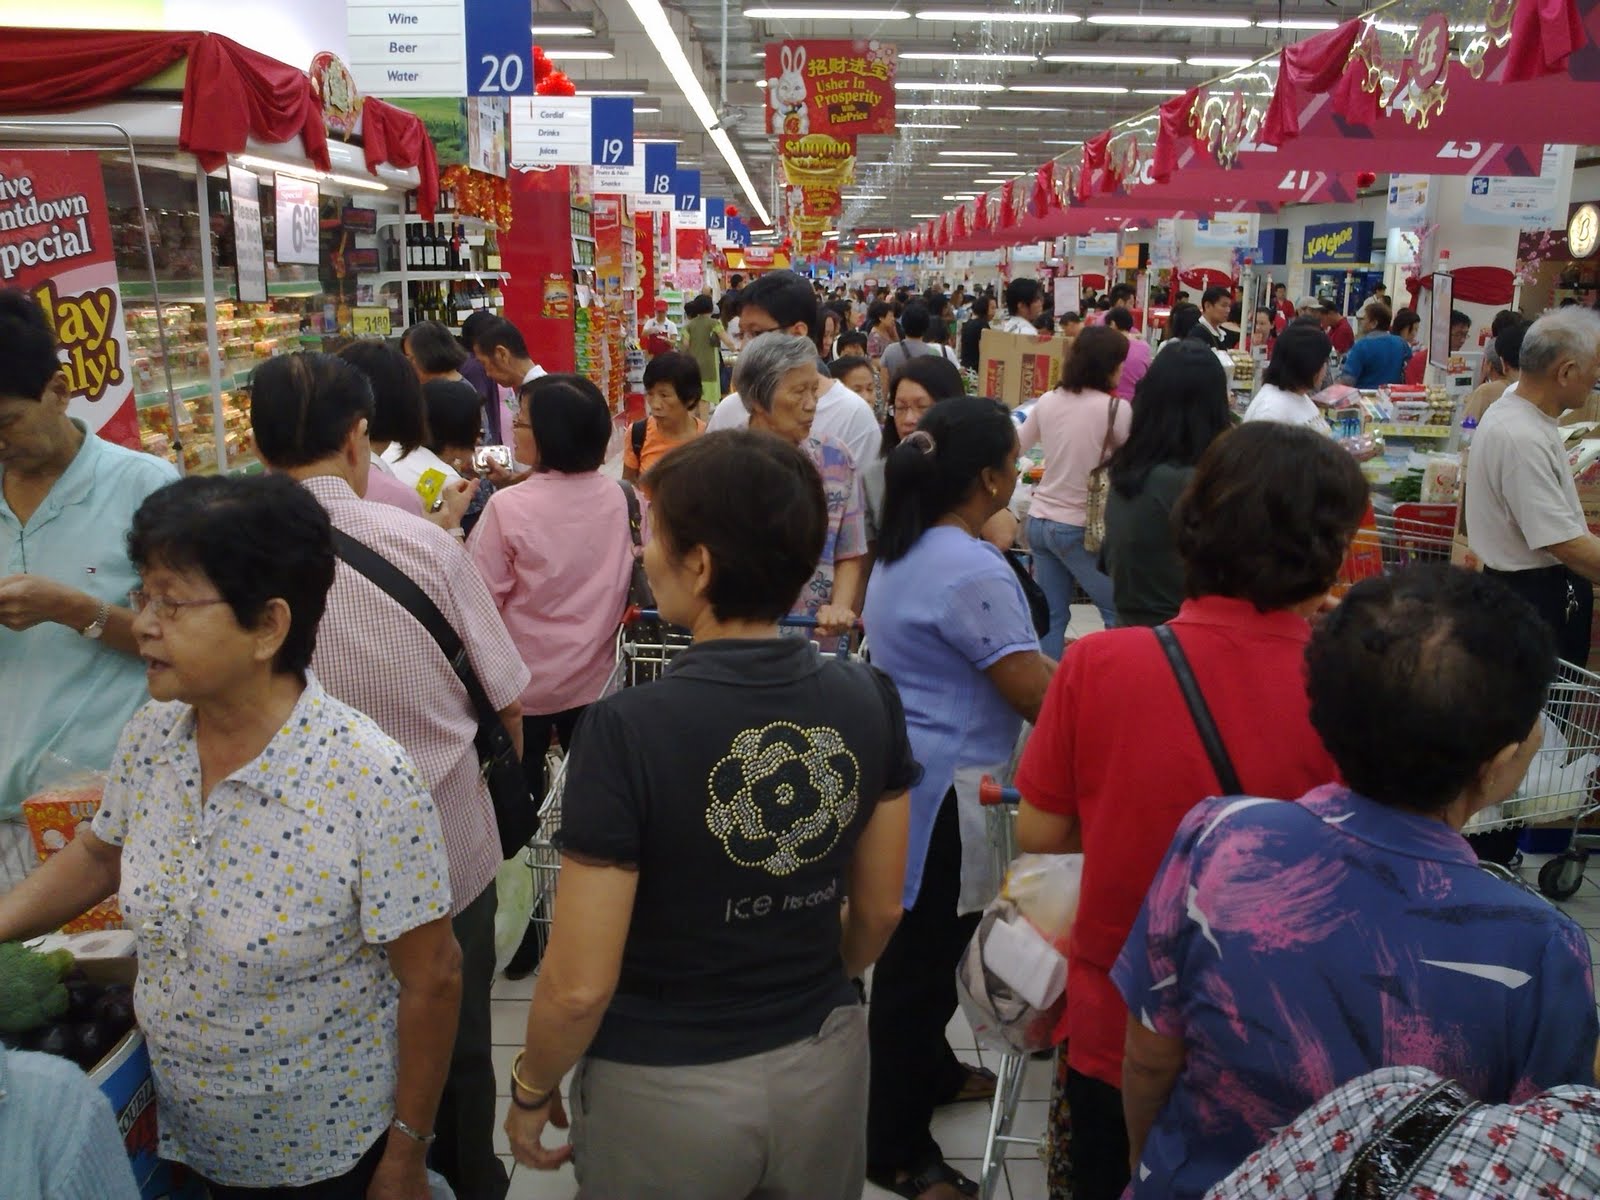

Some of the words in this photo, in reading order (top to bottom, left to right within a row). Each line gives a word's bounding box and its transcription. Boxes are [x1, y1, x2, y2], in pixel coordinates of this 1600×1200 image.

[388, 13, 418, 24] Wine
[389, 42, 418, 53] Beer
[387, 70, 419, 82] Water
[479, 55, 523, 92] 20
[807, 57, 888, 81] 招财进宝
[816, 78, 849, 93] Usher
[853, 77, 865, 89] In
[814, 90, 882, 109] Prosperity
[540, 111, 564, 119] Cordial
[831, 111, 868, 124] FairPrice
[538, 129, 560, 137] Drinks
[539, 147, 558, 156] Juices
[602, 139, 623, 163] 19
[785, 141, 851, 159] $100,000
[653, 174, 670, 193] 18
[682, 195, 695, 210] 17
[710, 215, 720, 228] 15
[0, 217, 92, 278] pecial
